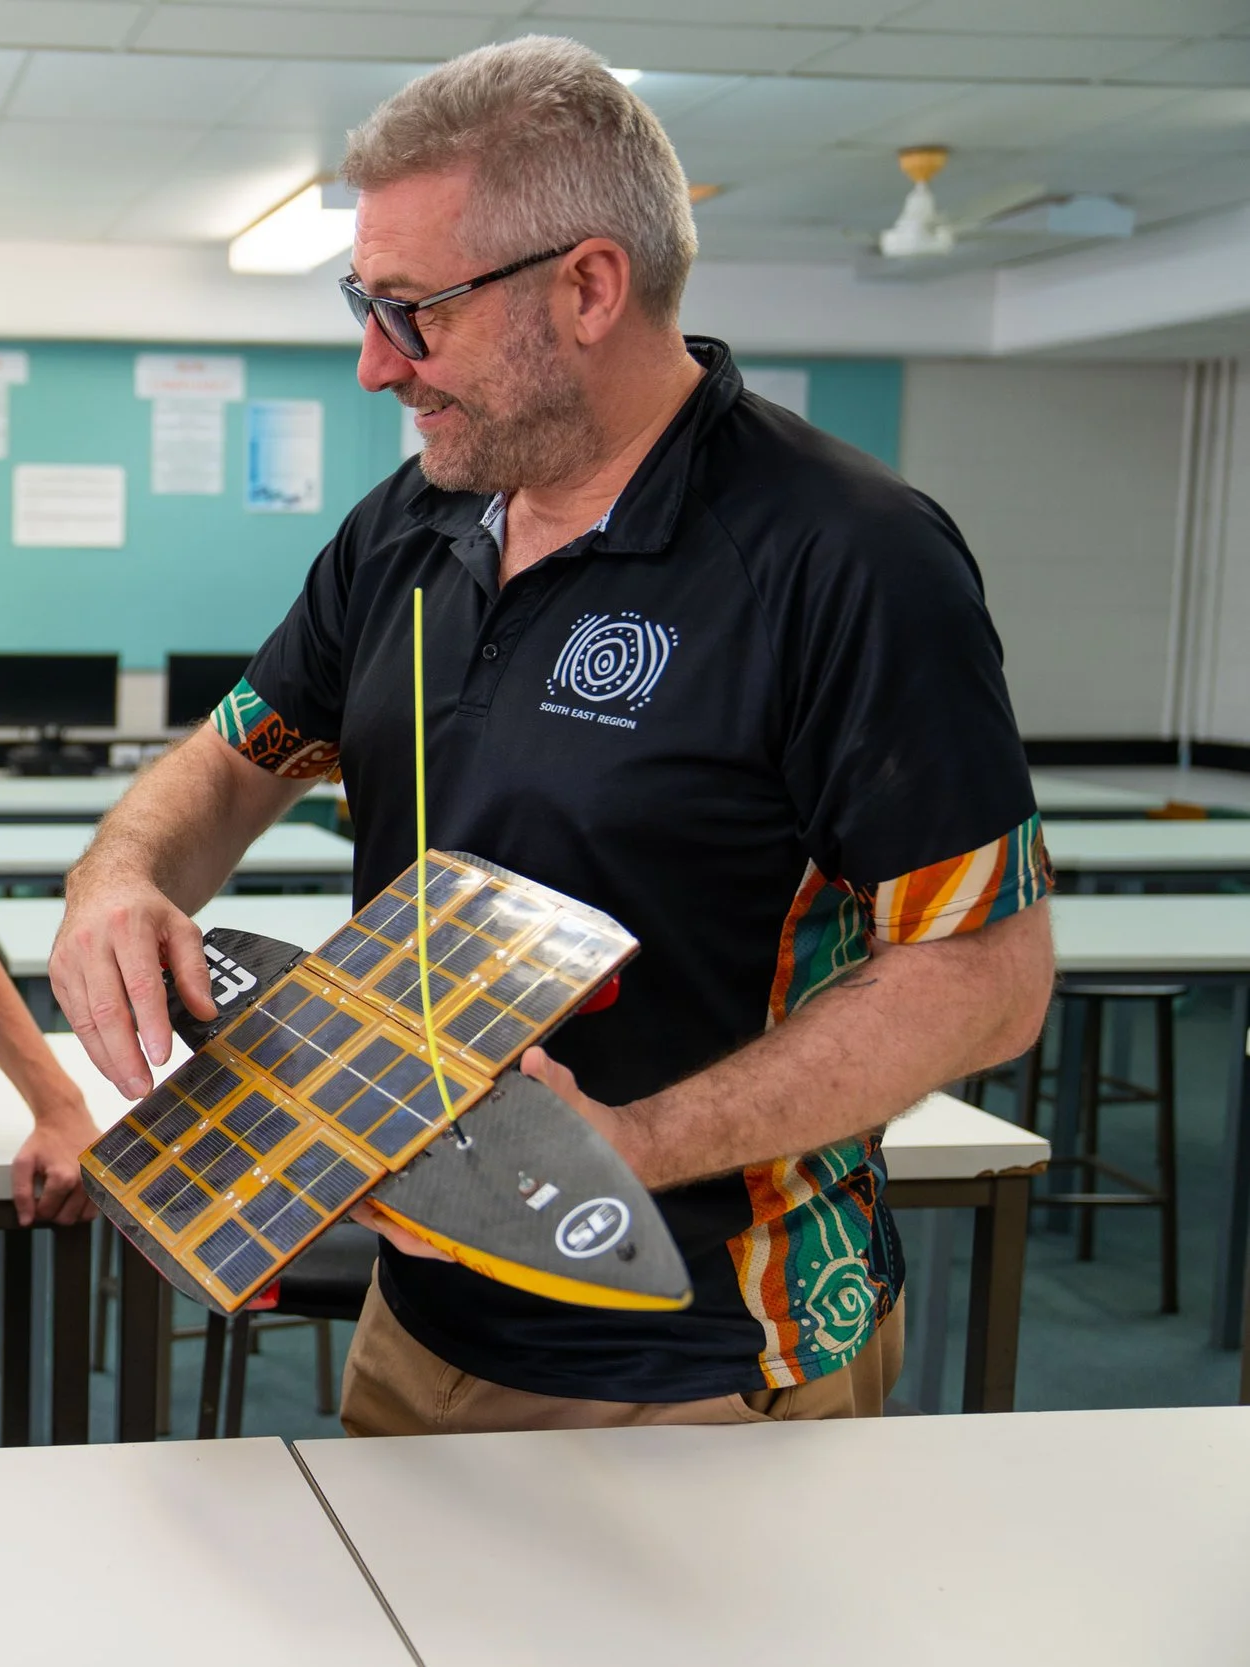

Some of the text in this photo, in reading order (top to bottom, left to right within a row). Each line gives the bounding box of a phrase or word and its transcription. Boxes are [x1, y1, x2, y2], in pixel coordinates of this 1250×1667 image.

[539, 702, 637, 729] SOUTH EAST REGION
